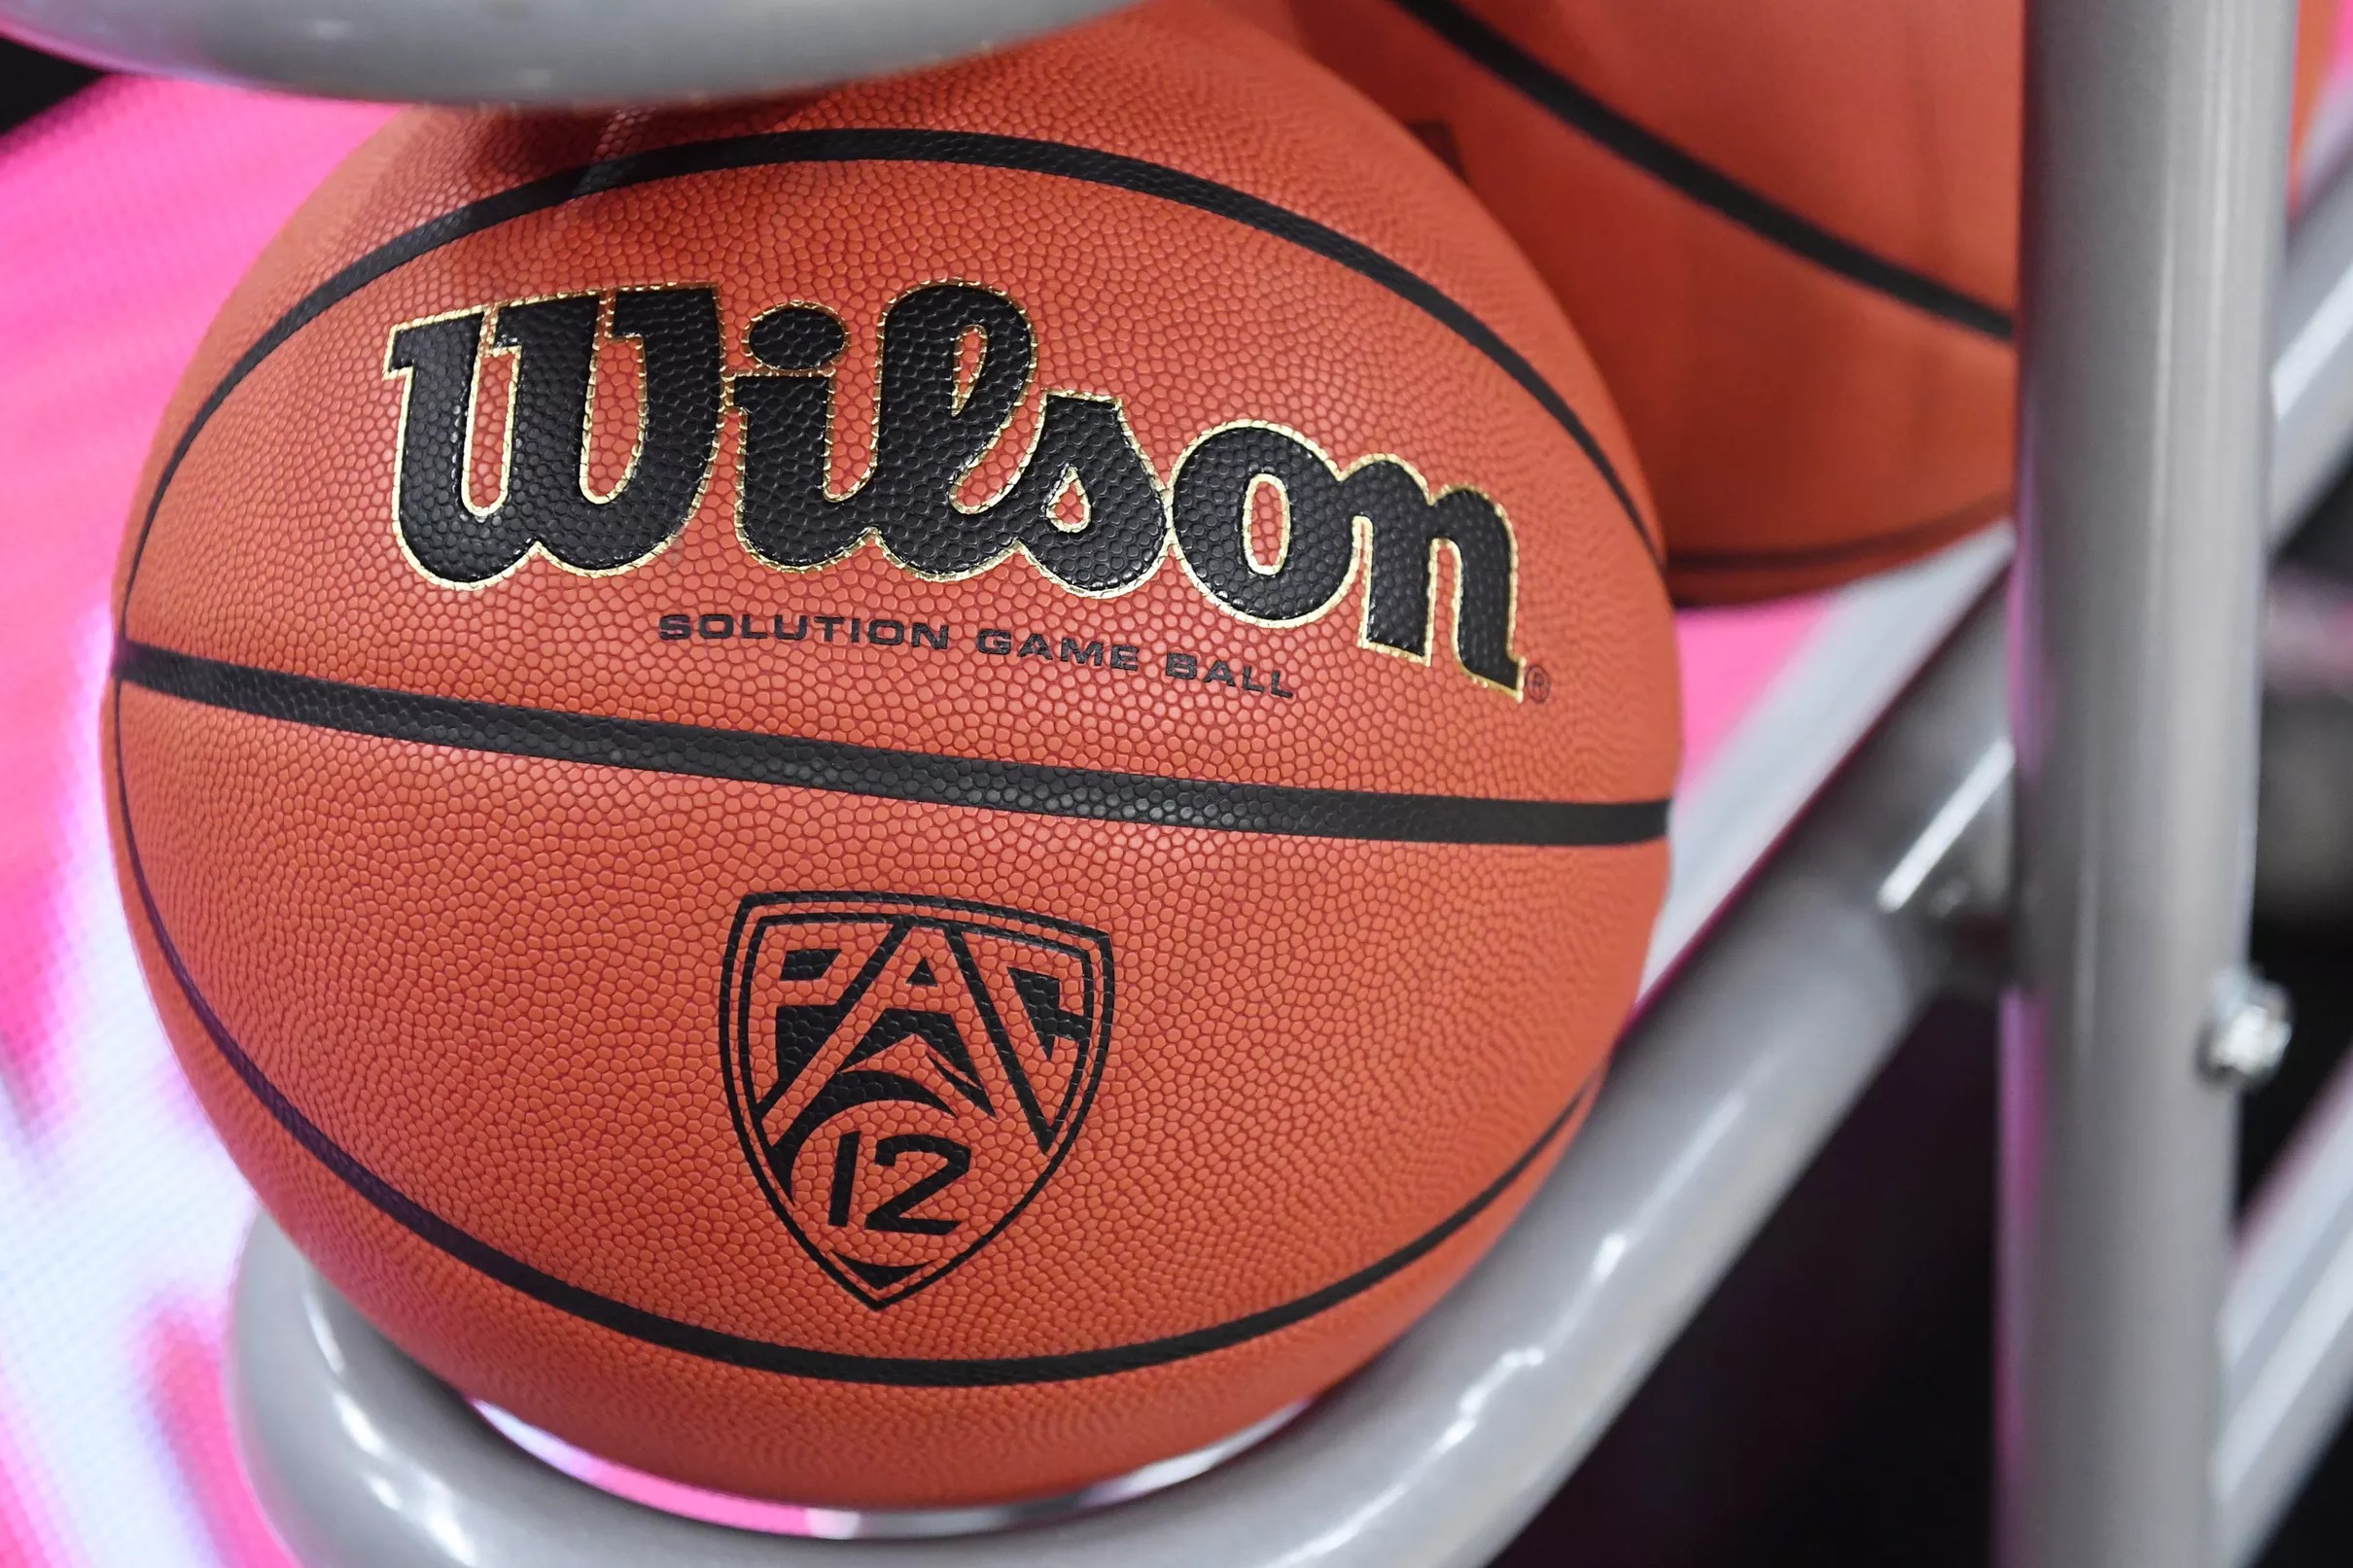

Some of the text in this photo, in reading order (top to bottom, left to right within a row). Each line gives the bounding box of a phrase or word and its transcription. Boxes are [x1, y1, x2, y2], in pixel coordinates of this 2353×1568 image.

[382, 278, 1527, 704] Wilson
[657, 612, 1294, 699] SOLUTION GAME BALL
[748, 919, 1087, 1132] PAC
[827, 1131, 972, 1236] 12
